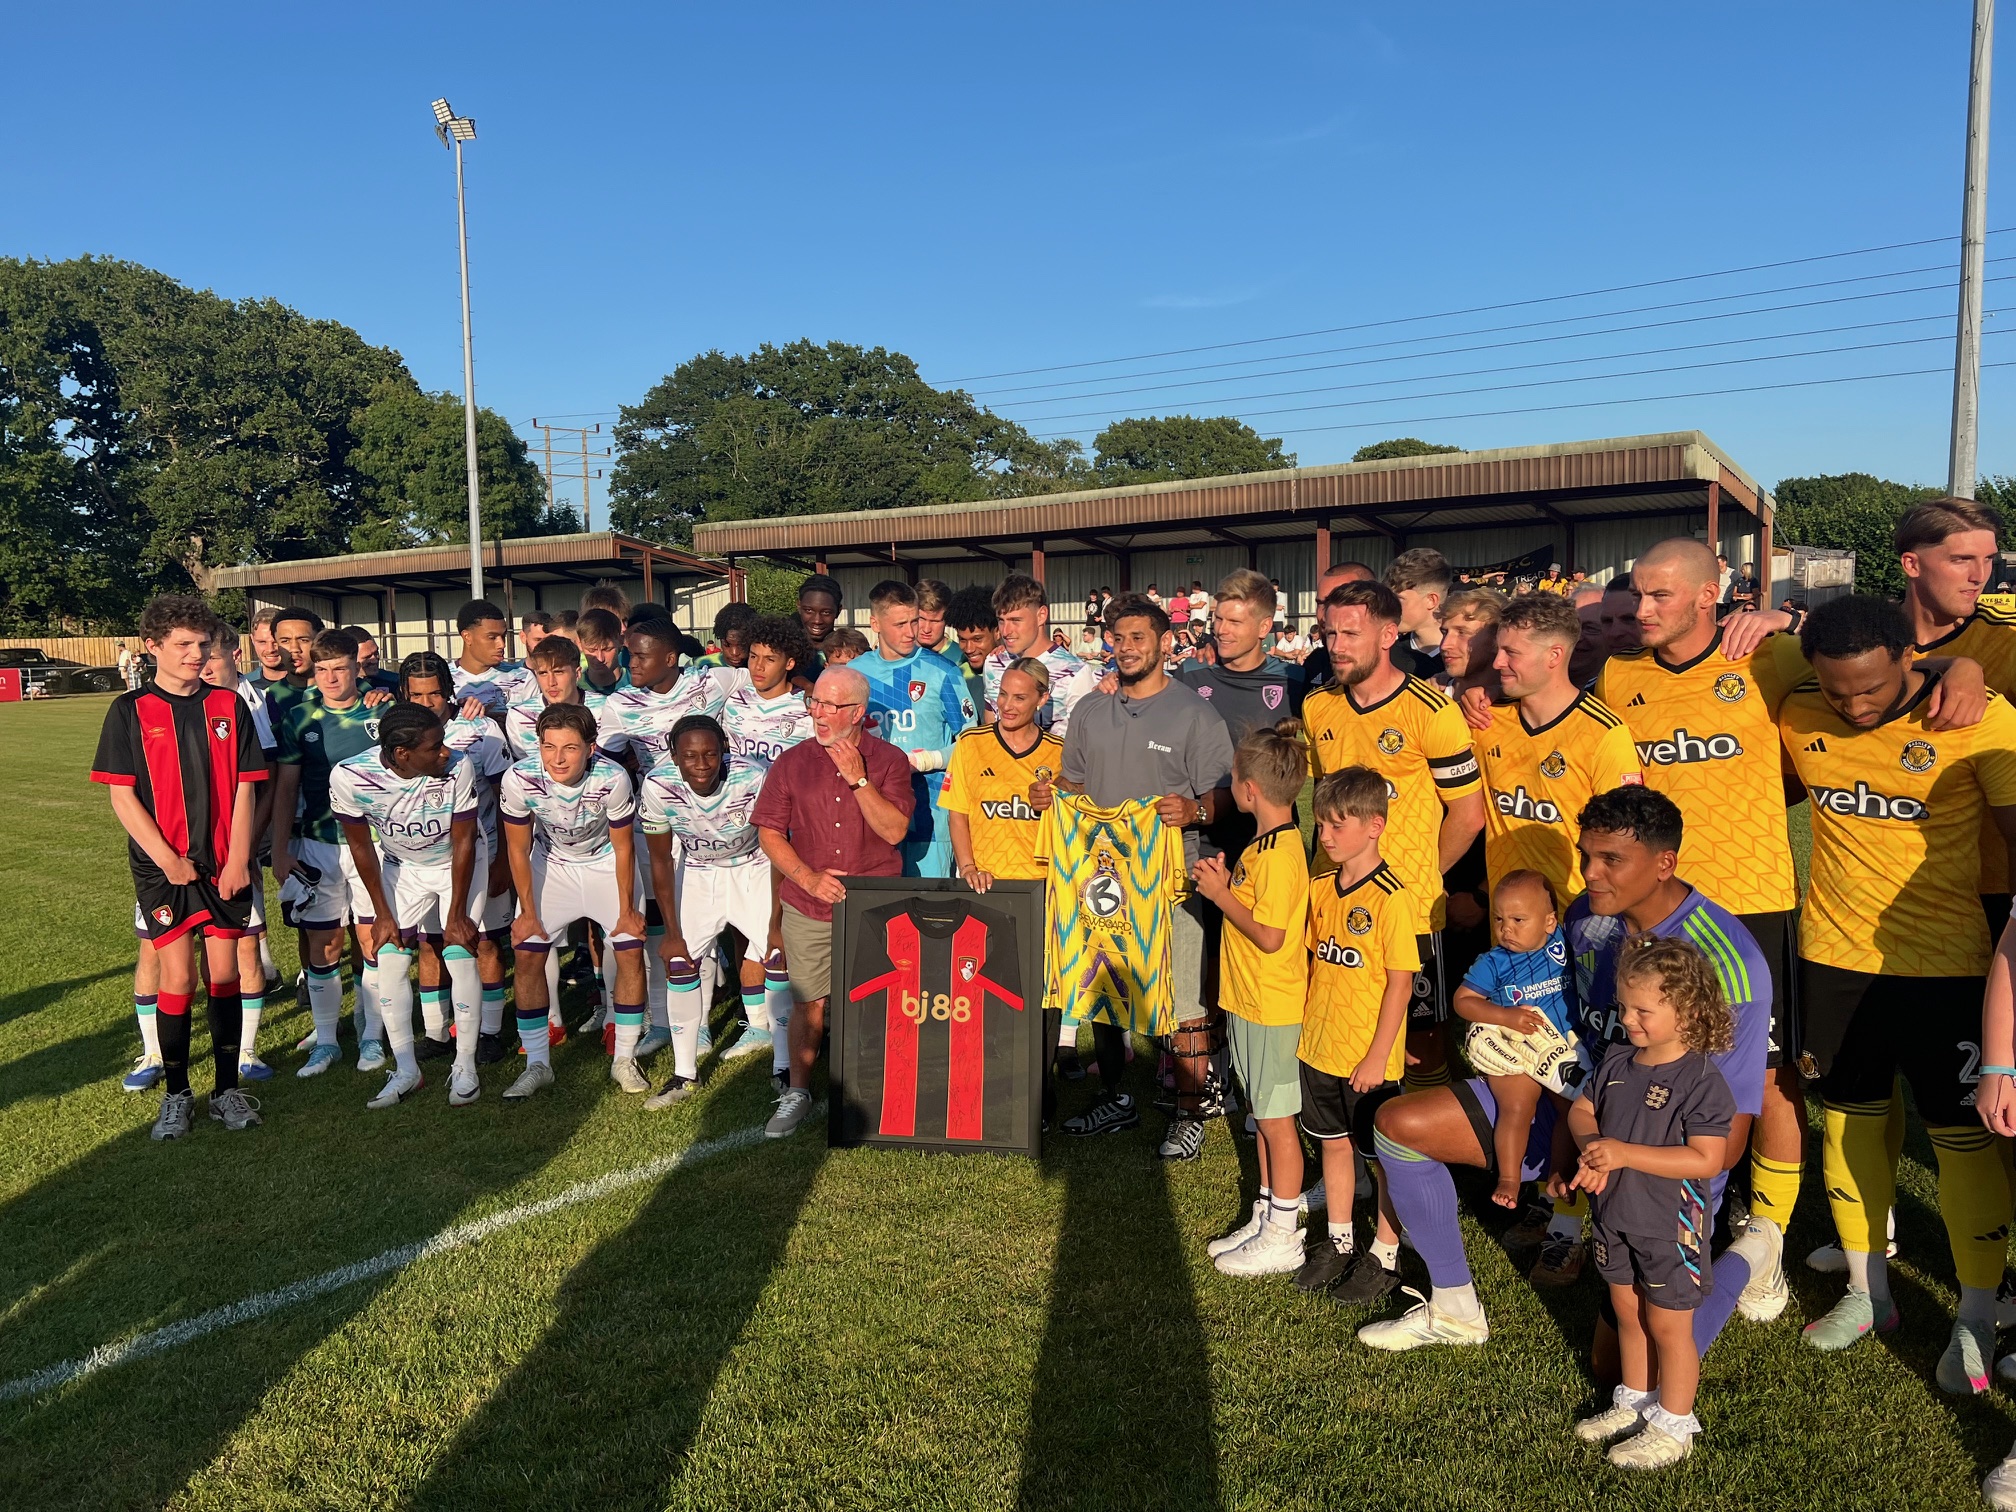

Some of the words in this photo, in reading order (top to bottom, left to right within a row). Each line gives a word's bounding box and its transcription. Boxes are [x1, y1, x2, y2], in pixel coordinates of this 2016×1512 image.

[870, 709, 916, 731] PRO
[1635, 731, 1736, 764] veho
[1450, 760, 1477, 776] CAPTA
[981, 796, 1040, 819] veh
[1494, 787, 1558, 821] eho
[1316, 937, 1361, 966] eho
[901, 990, 971, 1025] bj88
[1579, 998, 1627, 1040] veh
[1536, 1043, 1568, 1077] reusch
